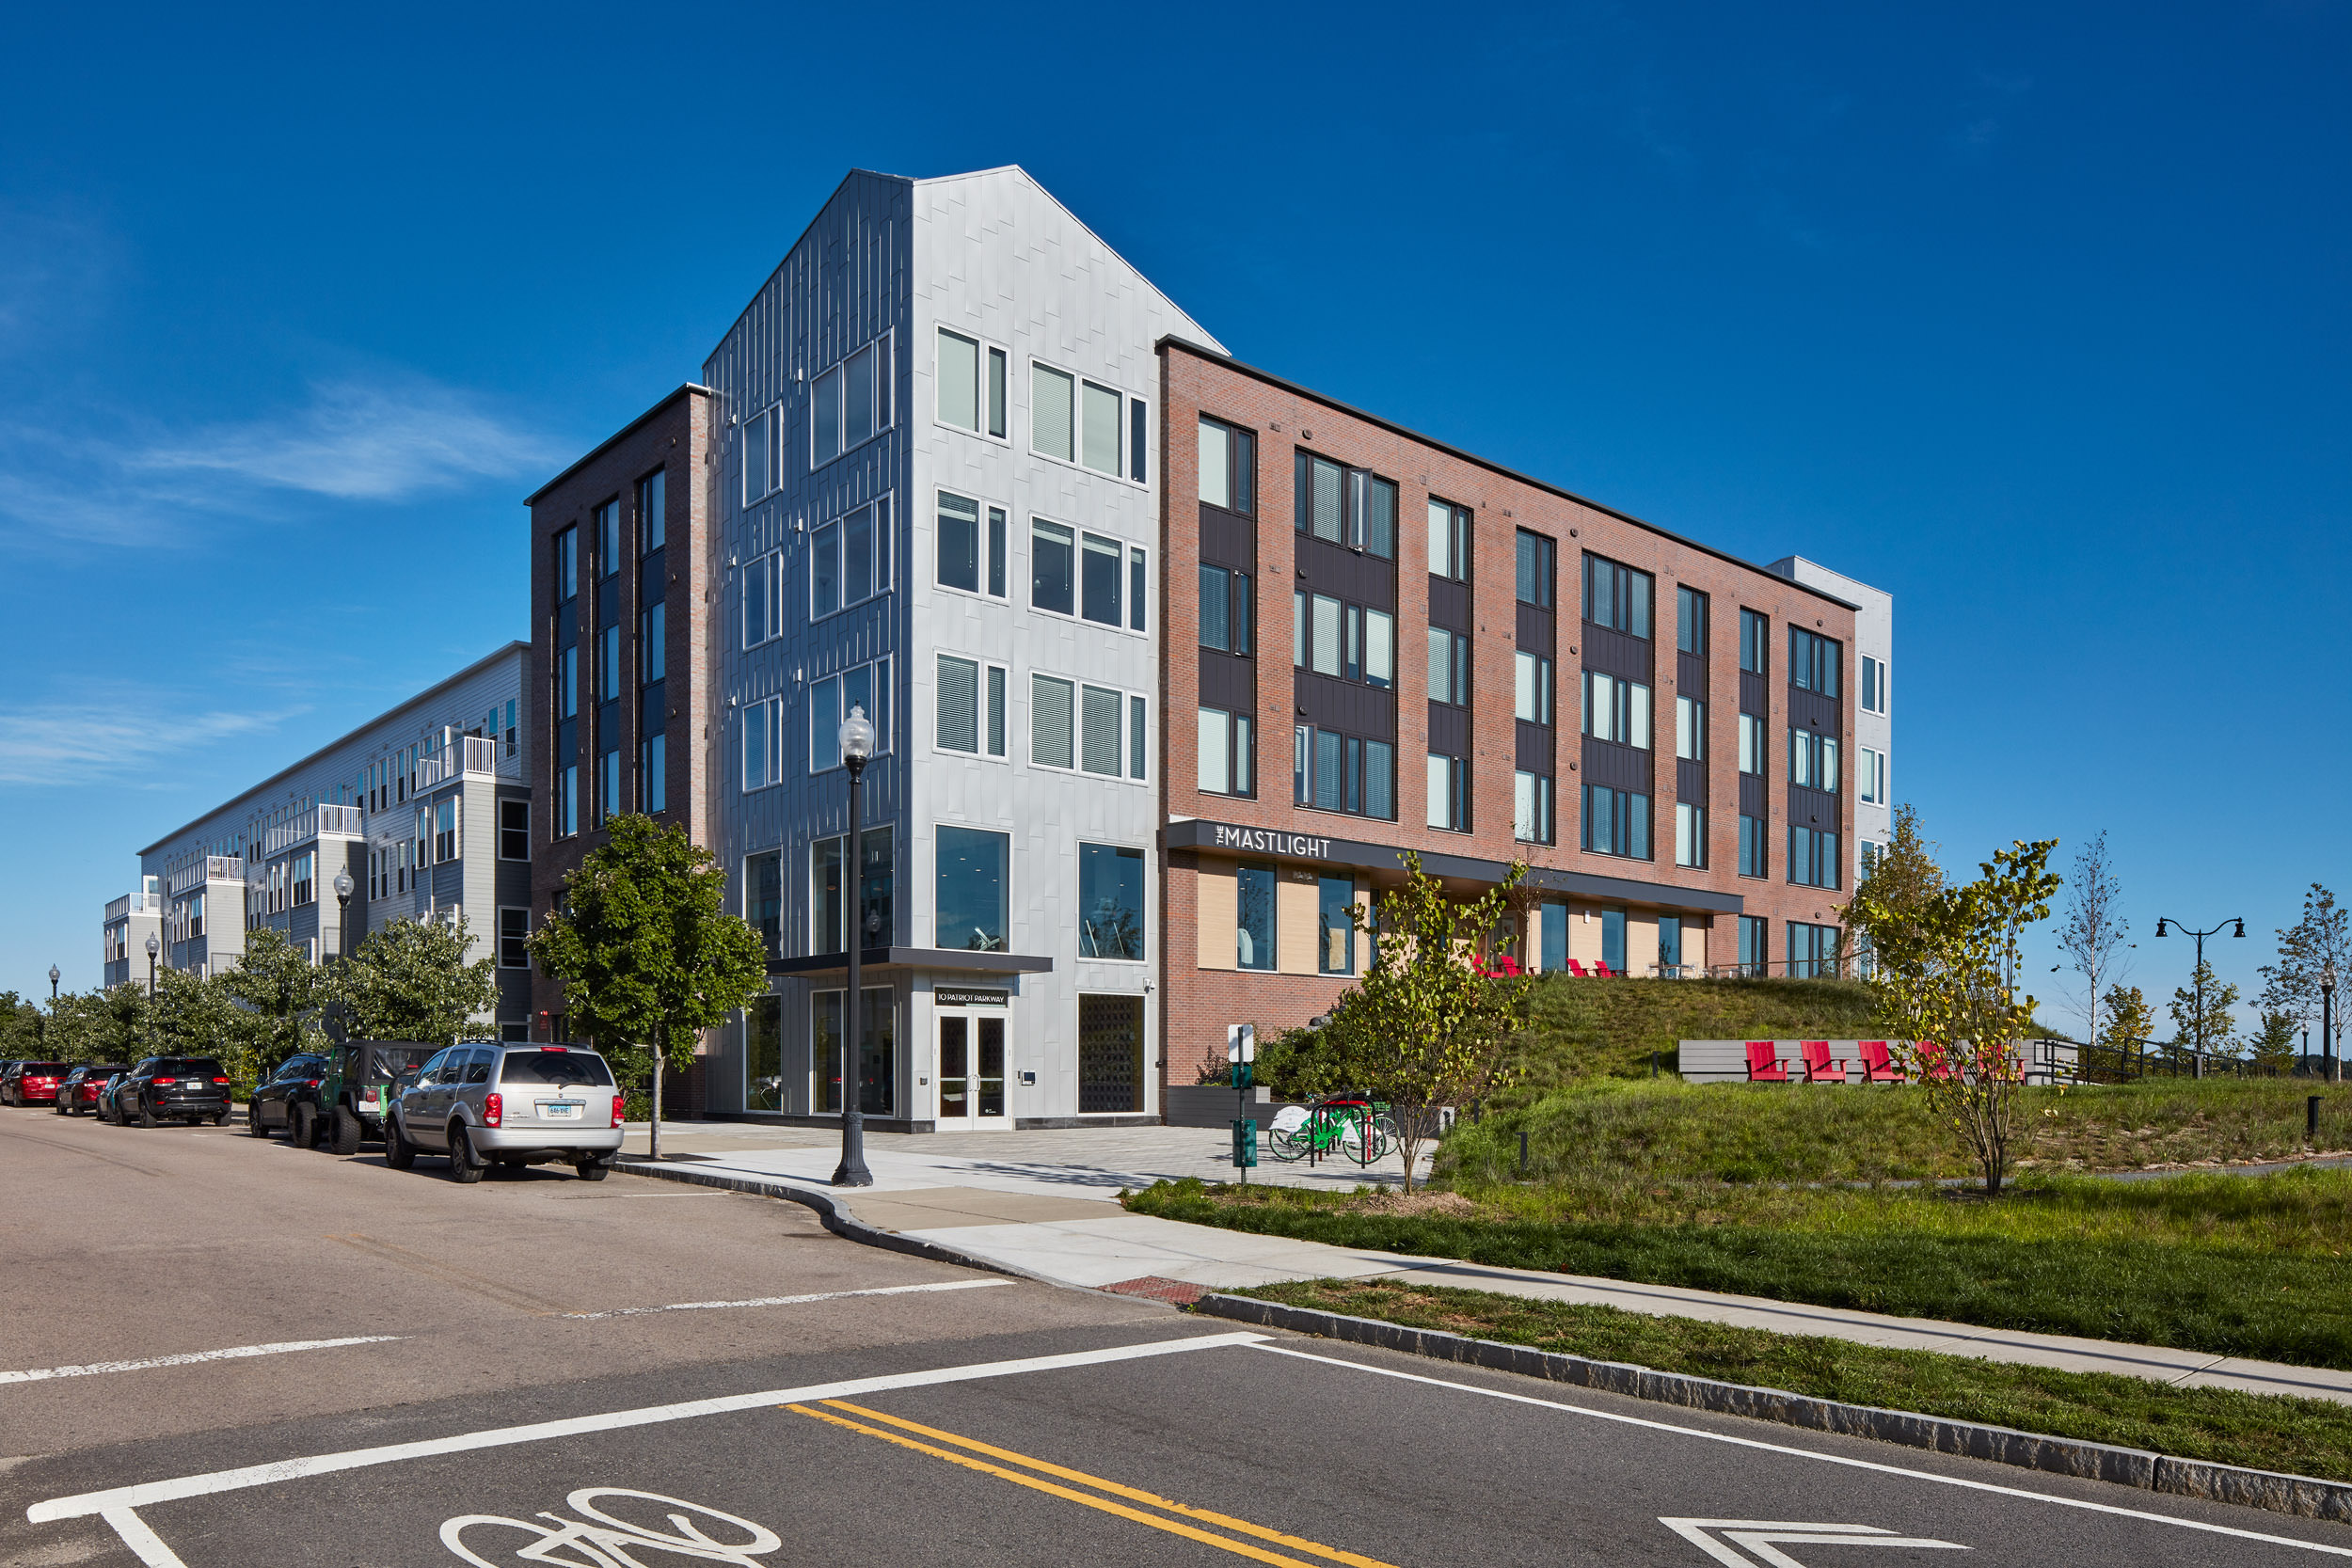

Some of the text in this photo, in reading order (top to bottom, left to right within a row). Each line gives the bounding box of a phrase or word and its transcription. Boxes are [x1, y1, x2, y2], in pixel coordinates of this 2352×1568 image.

[1225, 826, 1330, 859] MASTLIGHT
[947, 993, 973, 1002] PATRIOT
[974, 994, 1004, 1003] PARKWAY
